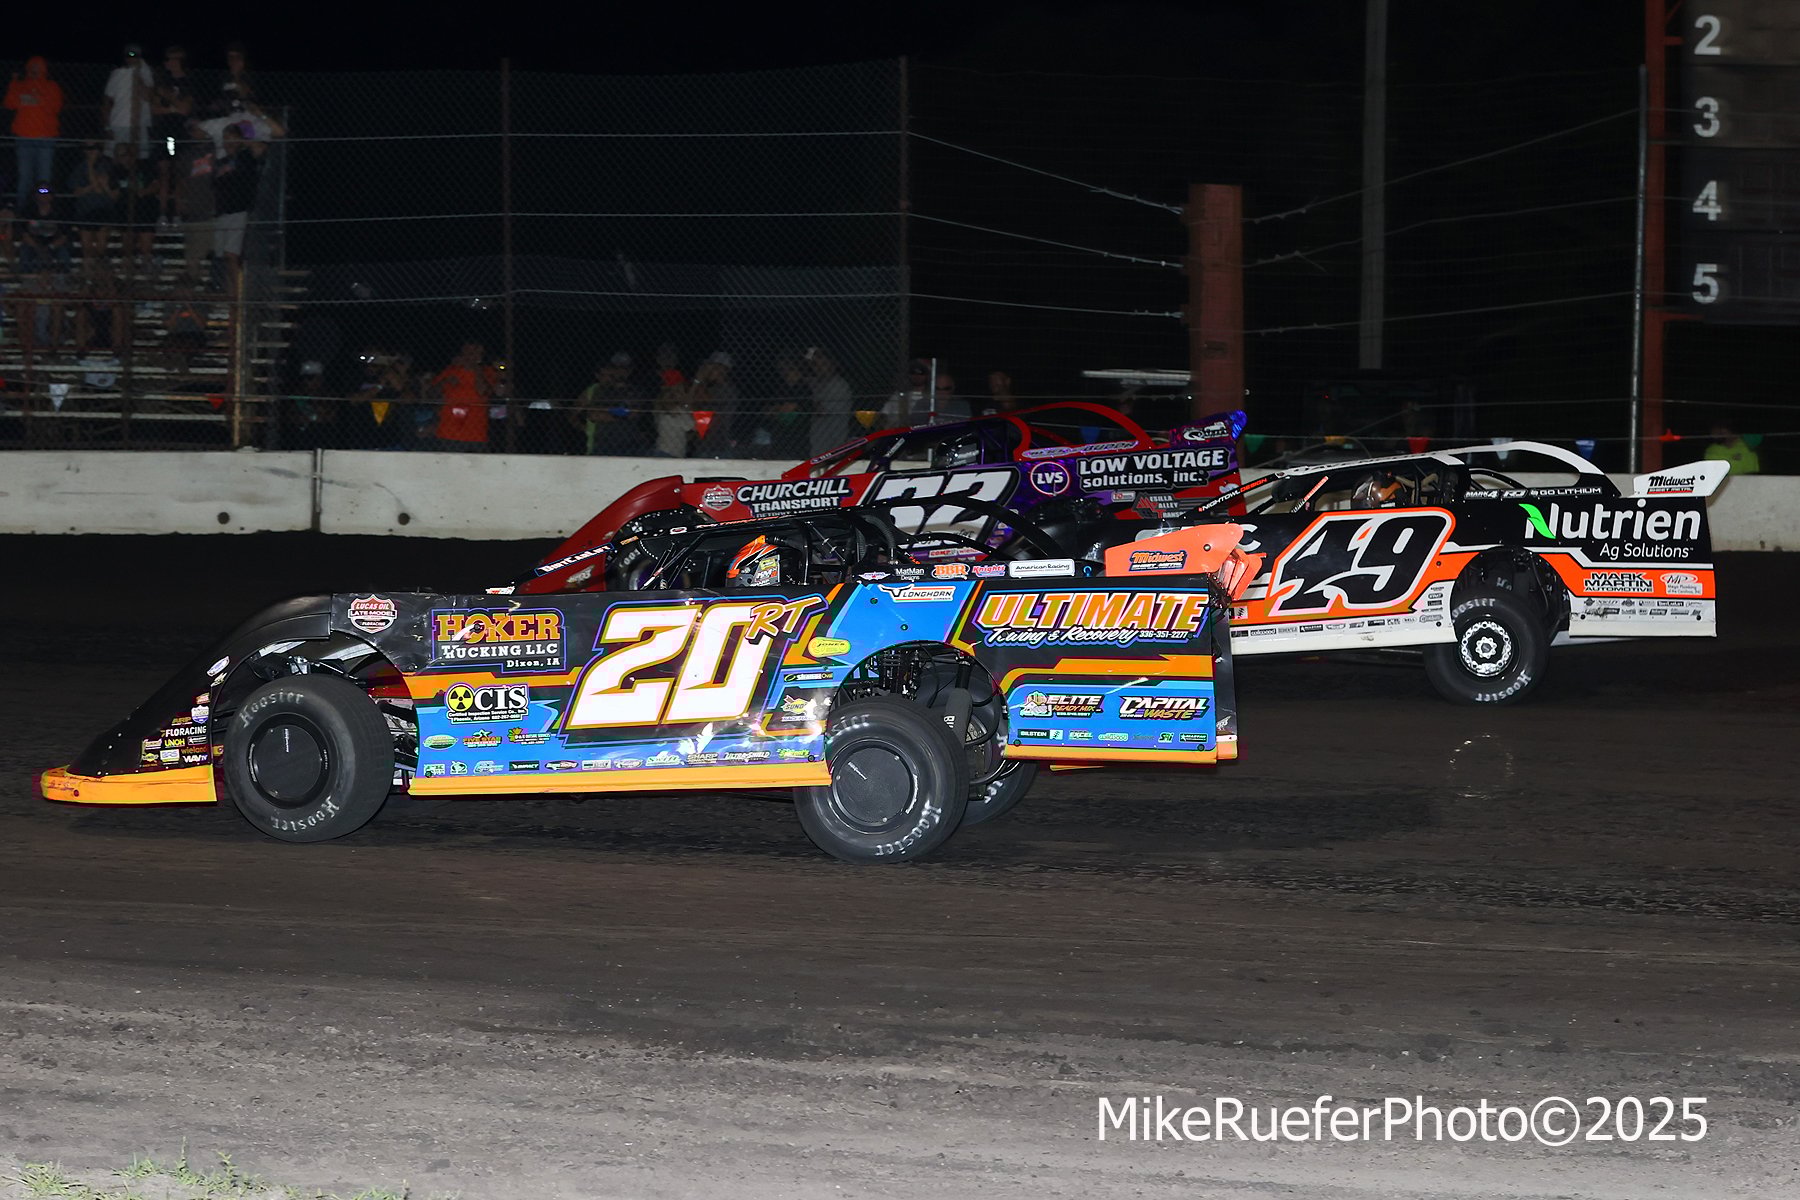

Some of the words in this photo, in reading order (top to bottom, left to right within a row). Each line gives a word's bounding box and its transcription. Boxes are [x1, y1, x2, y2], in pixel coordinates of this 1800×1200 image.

[1694, 15, 1721, 55] 2
[1693, 97, 1720, 137] 3
[1692, 181, 1722, 221] 4
[1692, 263, 1719, 304] 5
[1080, 456, 1130, 475] LOW
[1133, 450, 1224, 470] VOLTAGE
[1037, 472, 1064, 485] LVS
[1083, 472, 1168, 488] solutions,
[1649, 475, 1695, 486] Midwest
[737, 479, 849, 501] CHURCHILL
[752, 496, 839, 513] TRANSPORT
[1519, 499, 1701, 540] Nutrien
[1132, 552, 1185, 563] Midwest
[1600, 544, 1618, 560] Ag
[1624, 543, 1690, 558] Solutions
[896, 567, 924, 575] MatMan
[934, 565, 966, 575] BBR
[972, 564, 1005, 573] Knights
[1268, 511, 1452, 616] 49
[903, 590, 952, 598] LONGHORN
[977, 593, 1209, 632] ULTIMATE
[1452, 598, 1496, 623] oosier
[437, 613, 560, 643] HOKER
[988, 627, 1046, 644] Towing
[1048, 631, 1059, 640] &
[1062, 627, 1138, 645] Recovery
[526, 643, 558, 655] LLC
[506, 660, 544, 668] Dixon,
[547, 658, 560, 666] IA
[566, 602, 773, 729] 20
[745, 596, 822, 640] RT
[1475, 669, 1532, 702] Hoosier
[474, 686, 528, 711] CIS
[1046, 695, 1103, 705] ELITE
[1120, 697, 1207, 714] CAPITAL
[239, 688, 305, 728] Hoosier
[1143, 709, 1196, 719] WASTE
[165, 726, 206, 737] FLORACING
[164, 738, 185, 747] UNOH
[271, 795, 340, 834] Hoosier
[875, 800, 942, 855] Hoosier
